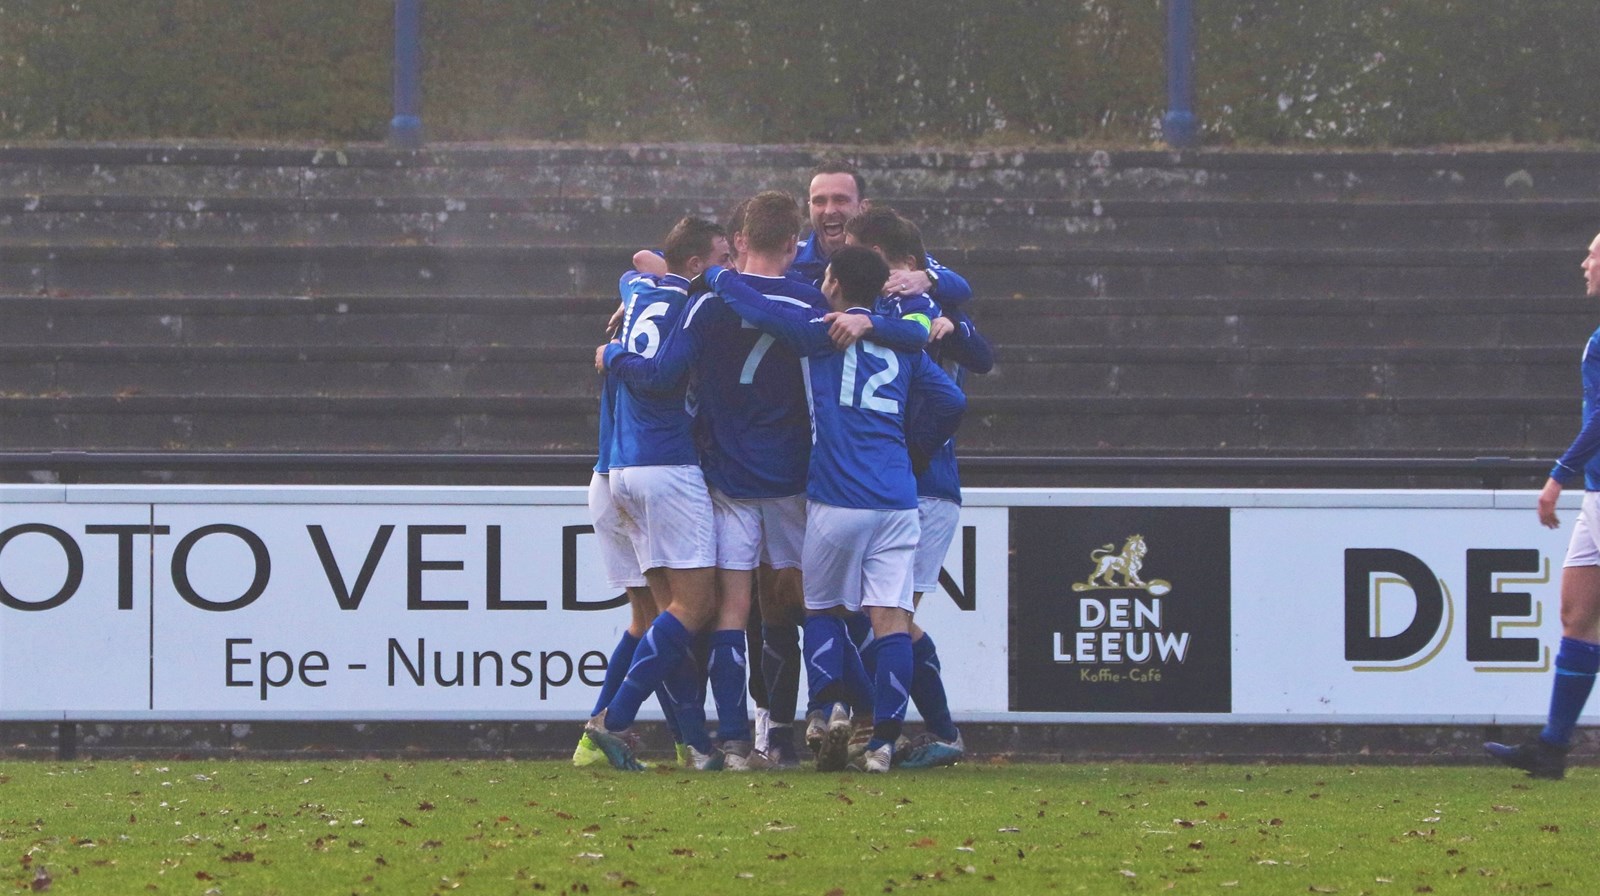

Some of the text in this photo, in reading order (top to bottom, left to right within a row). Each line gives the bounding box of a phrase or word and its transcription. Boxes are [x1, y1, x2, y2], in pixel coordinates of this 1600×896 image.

[739, 317, 778, 385] 7
[838, 339, 900, 415] 12
[1079, 598, 1163, 630] DEN
[1344, 548, 1549, 672] DE
[225, 638, 330, 701] Epe
[1053, 632, 1190, 664] LEEUW
